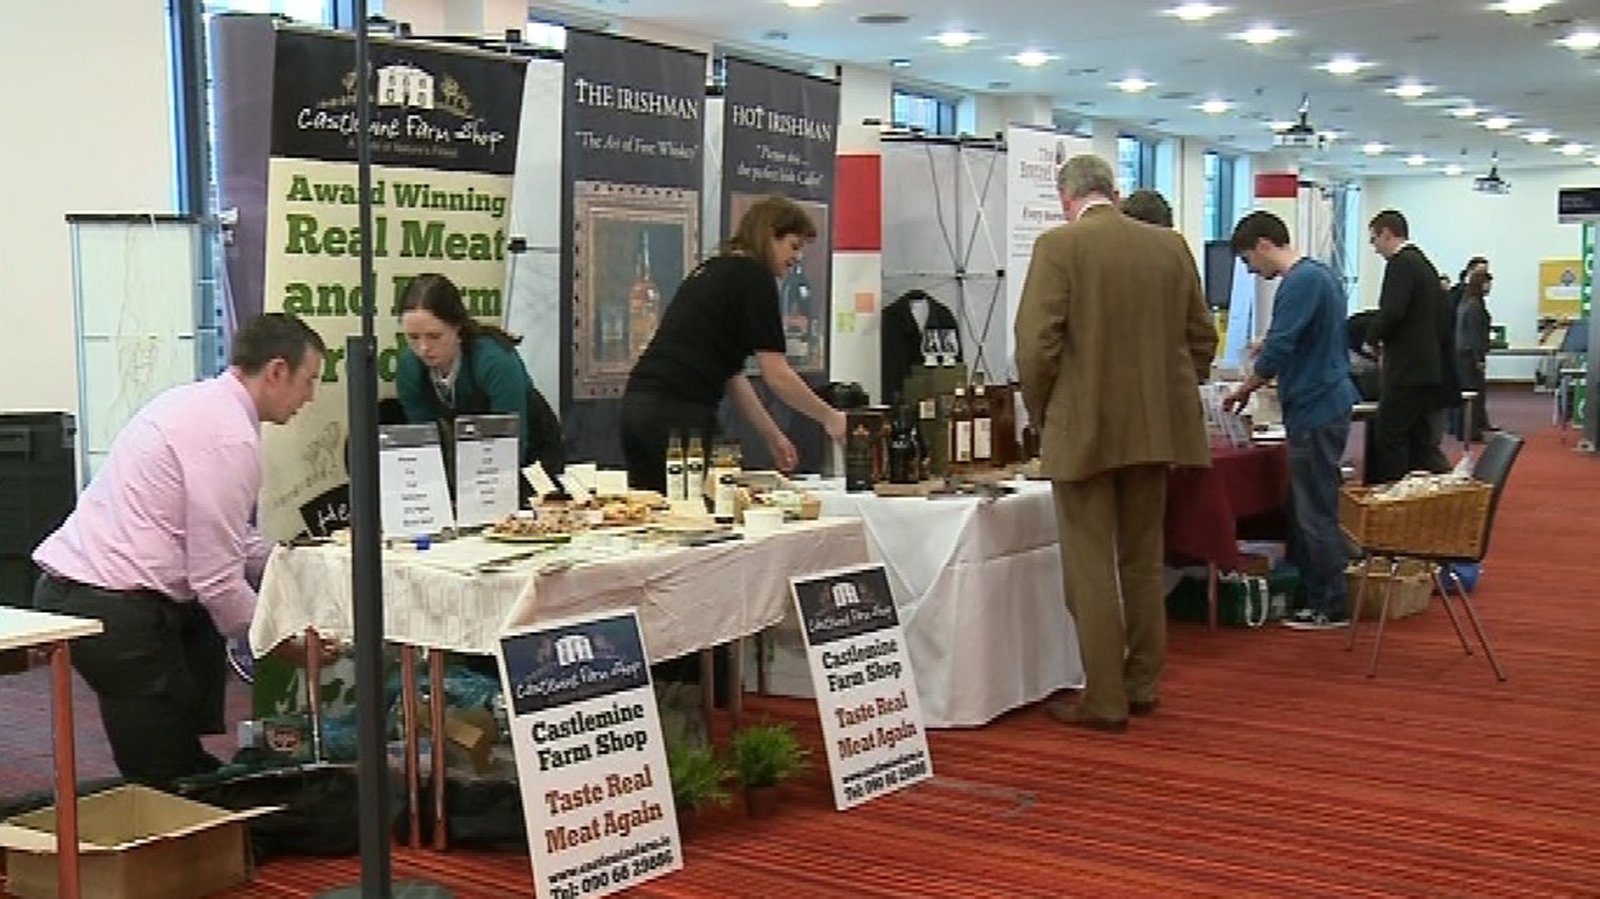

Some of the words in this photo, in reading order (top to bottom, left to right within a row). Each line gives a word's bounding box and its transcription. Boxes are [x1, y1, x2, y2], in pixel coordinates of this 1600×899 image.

[574, 78, 614, 106] THE
[617, 88, 699, 120] IRISHMAN
[406, 114, 450, 142] Farm
[733, 105, 765, 129] HOT
[767, 111, 831, 143] IRISHMAN
[286, 174, 386, 205] Awad
[393, 183, 507, 217] Winning
[400, 220, 505, 260] Meat
[531, 701, 645, 744] Castlemine
[537, 744, 593, 771] Farm
[596, 730, 648, 755] Shop
[545, 781, 604, 817] Taste
[605, 763, 654, 799] Real
[544, 818, 601, 854] Meat
[603, 800, 664, 837] Again
